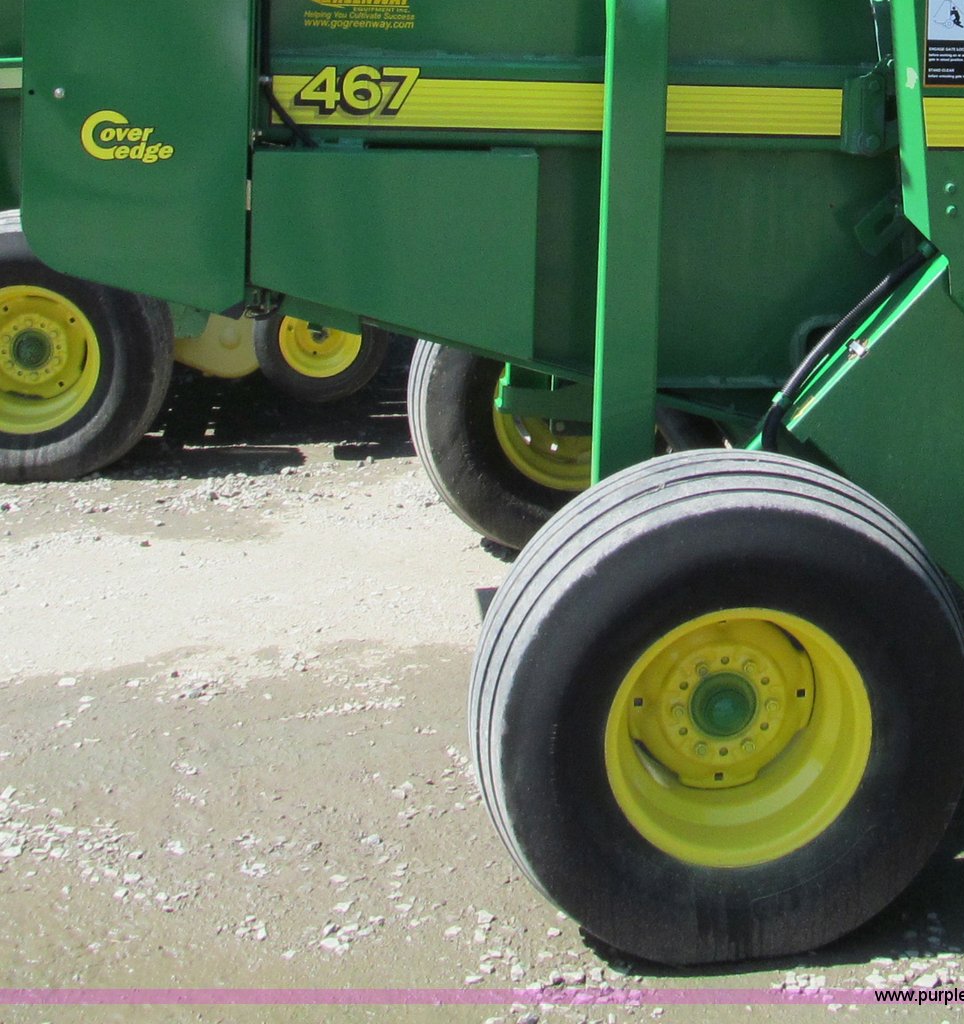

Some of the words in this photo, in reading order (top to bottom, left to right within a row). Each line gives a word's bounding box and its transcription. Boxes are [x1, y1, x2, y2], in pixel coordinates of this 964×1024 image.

[304, 10, 332, 19] Helping
[334, 11, 345, 19] You
[349, 11, 382, 19] Cultivate
[383, 12, 415, 20] Success
[304, 19, 415, 30] www.gogreenway.com
[294, 64, 421, 116] 467
[81, 108, 155, 161] Cover
[113, 141, 175, 164] edge
